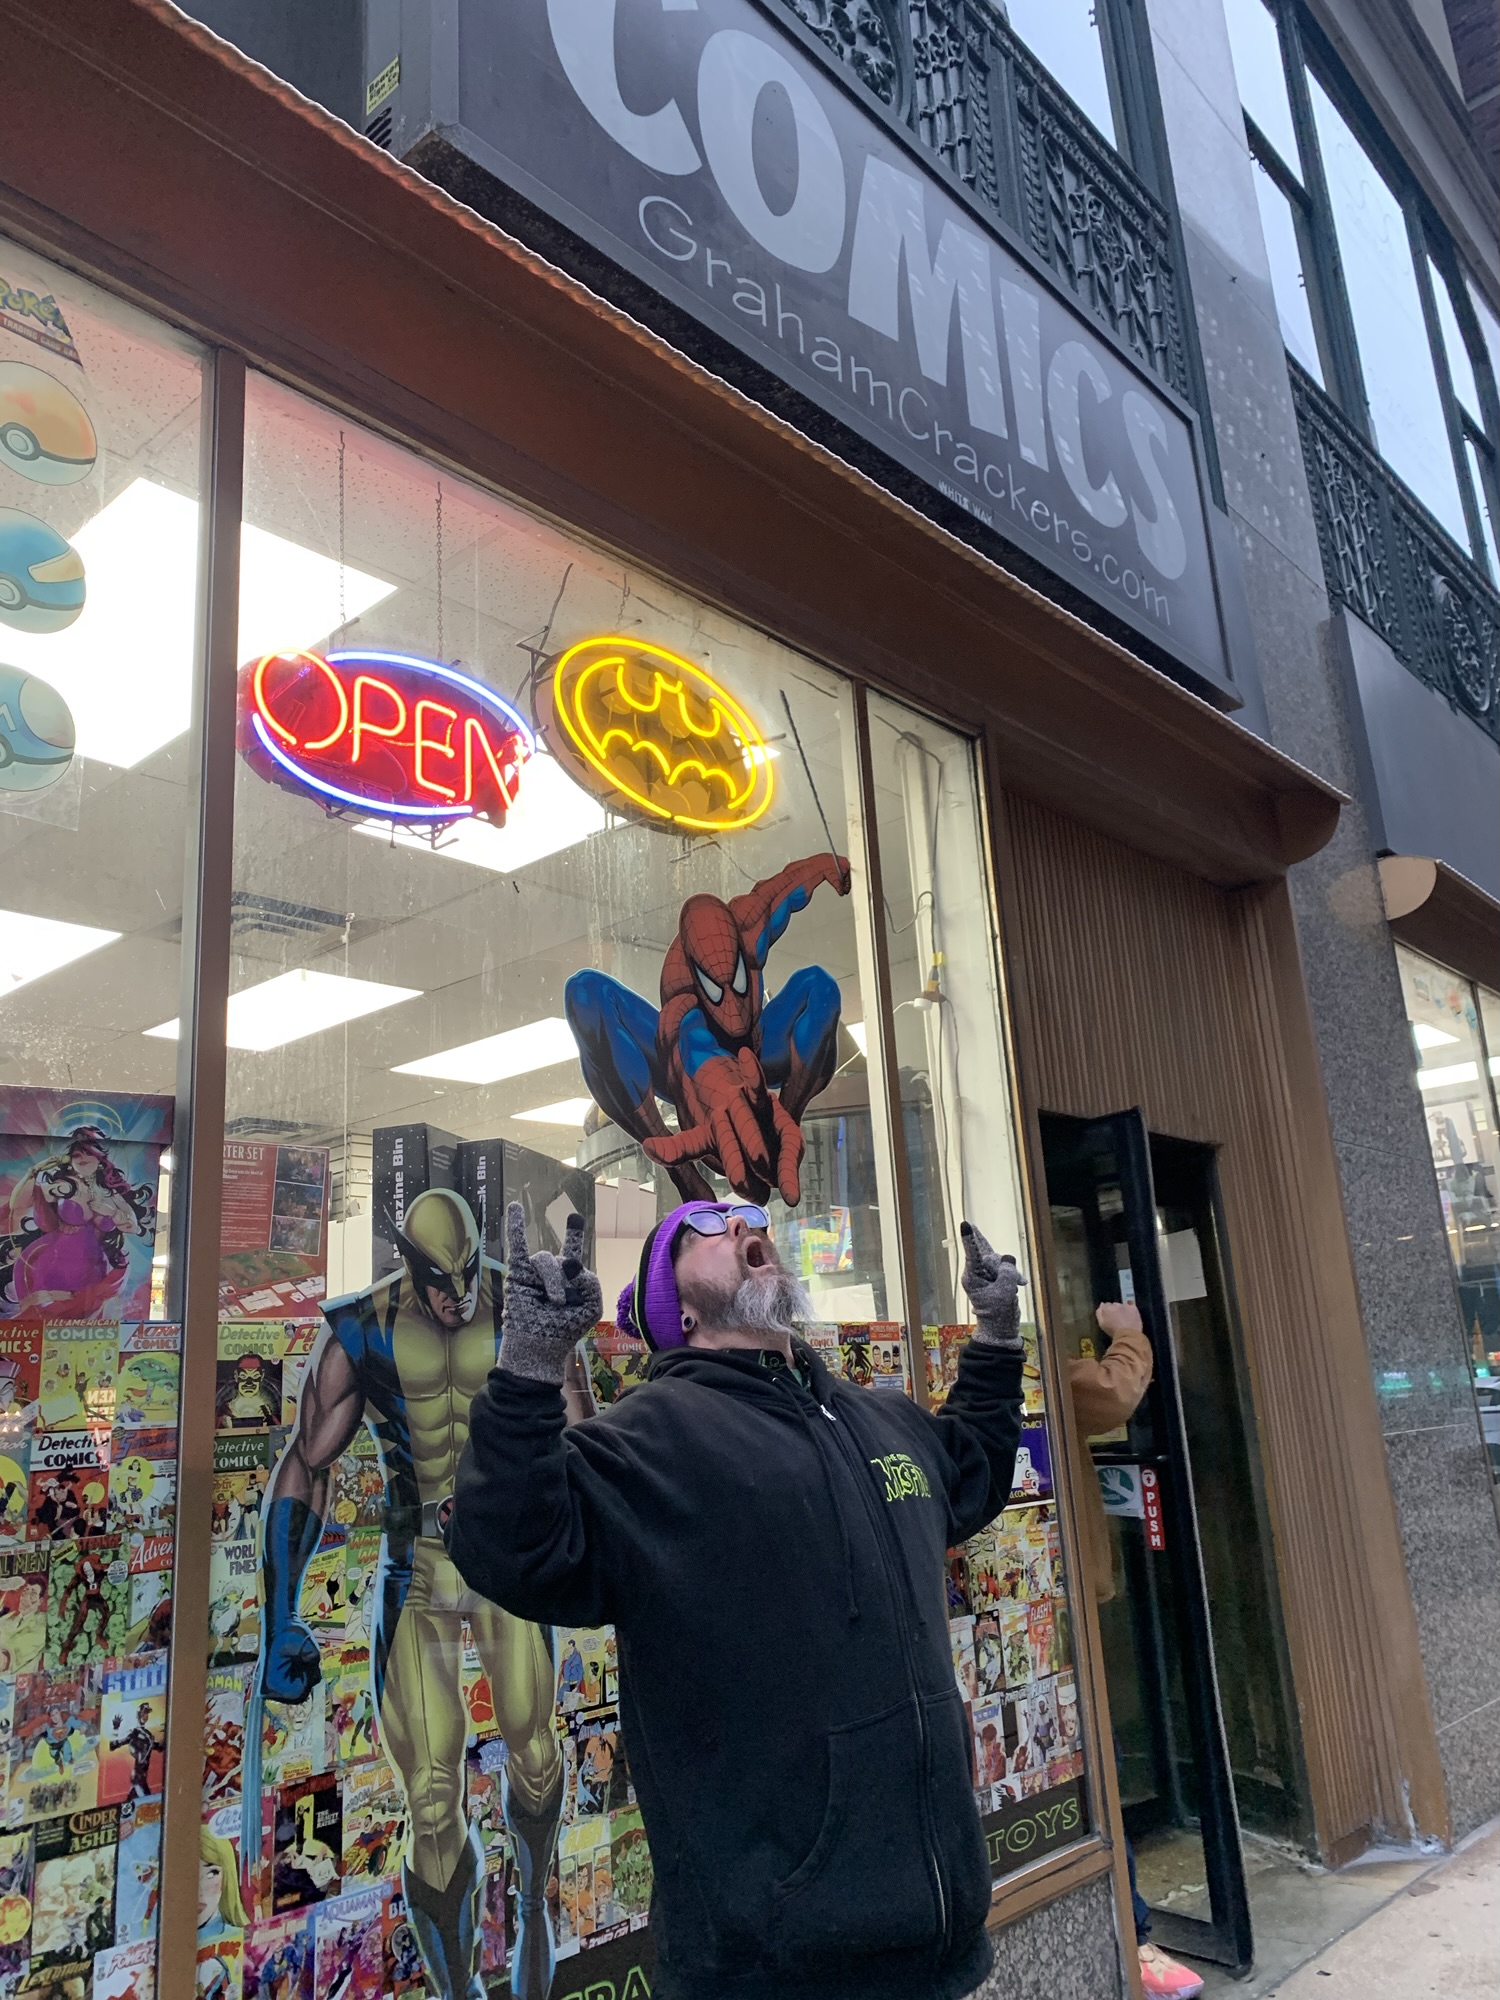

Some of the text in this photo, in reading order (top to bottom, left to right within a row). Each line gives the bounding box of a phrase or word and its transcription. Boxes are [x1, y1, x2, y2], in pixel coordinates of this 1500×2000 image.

[546, 0, 1187, 580] COMICS
[637, 195, 1171, 626] GrahamCrackers.com
[972, 503, 993, 527] WAY
[254, 648, 524, 812] OPEN
[246, 1147, 264, 1160] SET
[476, 1155, 487, 1180] Bin
[392, 1137, 404, 1259] Mgazine Bin
[47, 1327, 116, 1341] COMICS
[133, 1338, 178, 1350] COMICS
[219, 1325, 280, 1341] Detective
[223, 1342, 275, 1356] COMICS
[1145, 1491, 1161, 1547] PUSH
[13, 1550, 48, 1575] MEN
[69, 1807, 119, 1834] CINDER
[985, 1797, 1080, 1865] TOYS
[69, 1828, 118, 1853] ASHE
